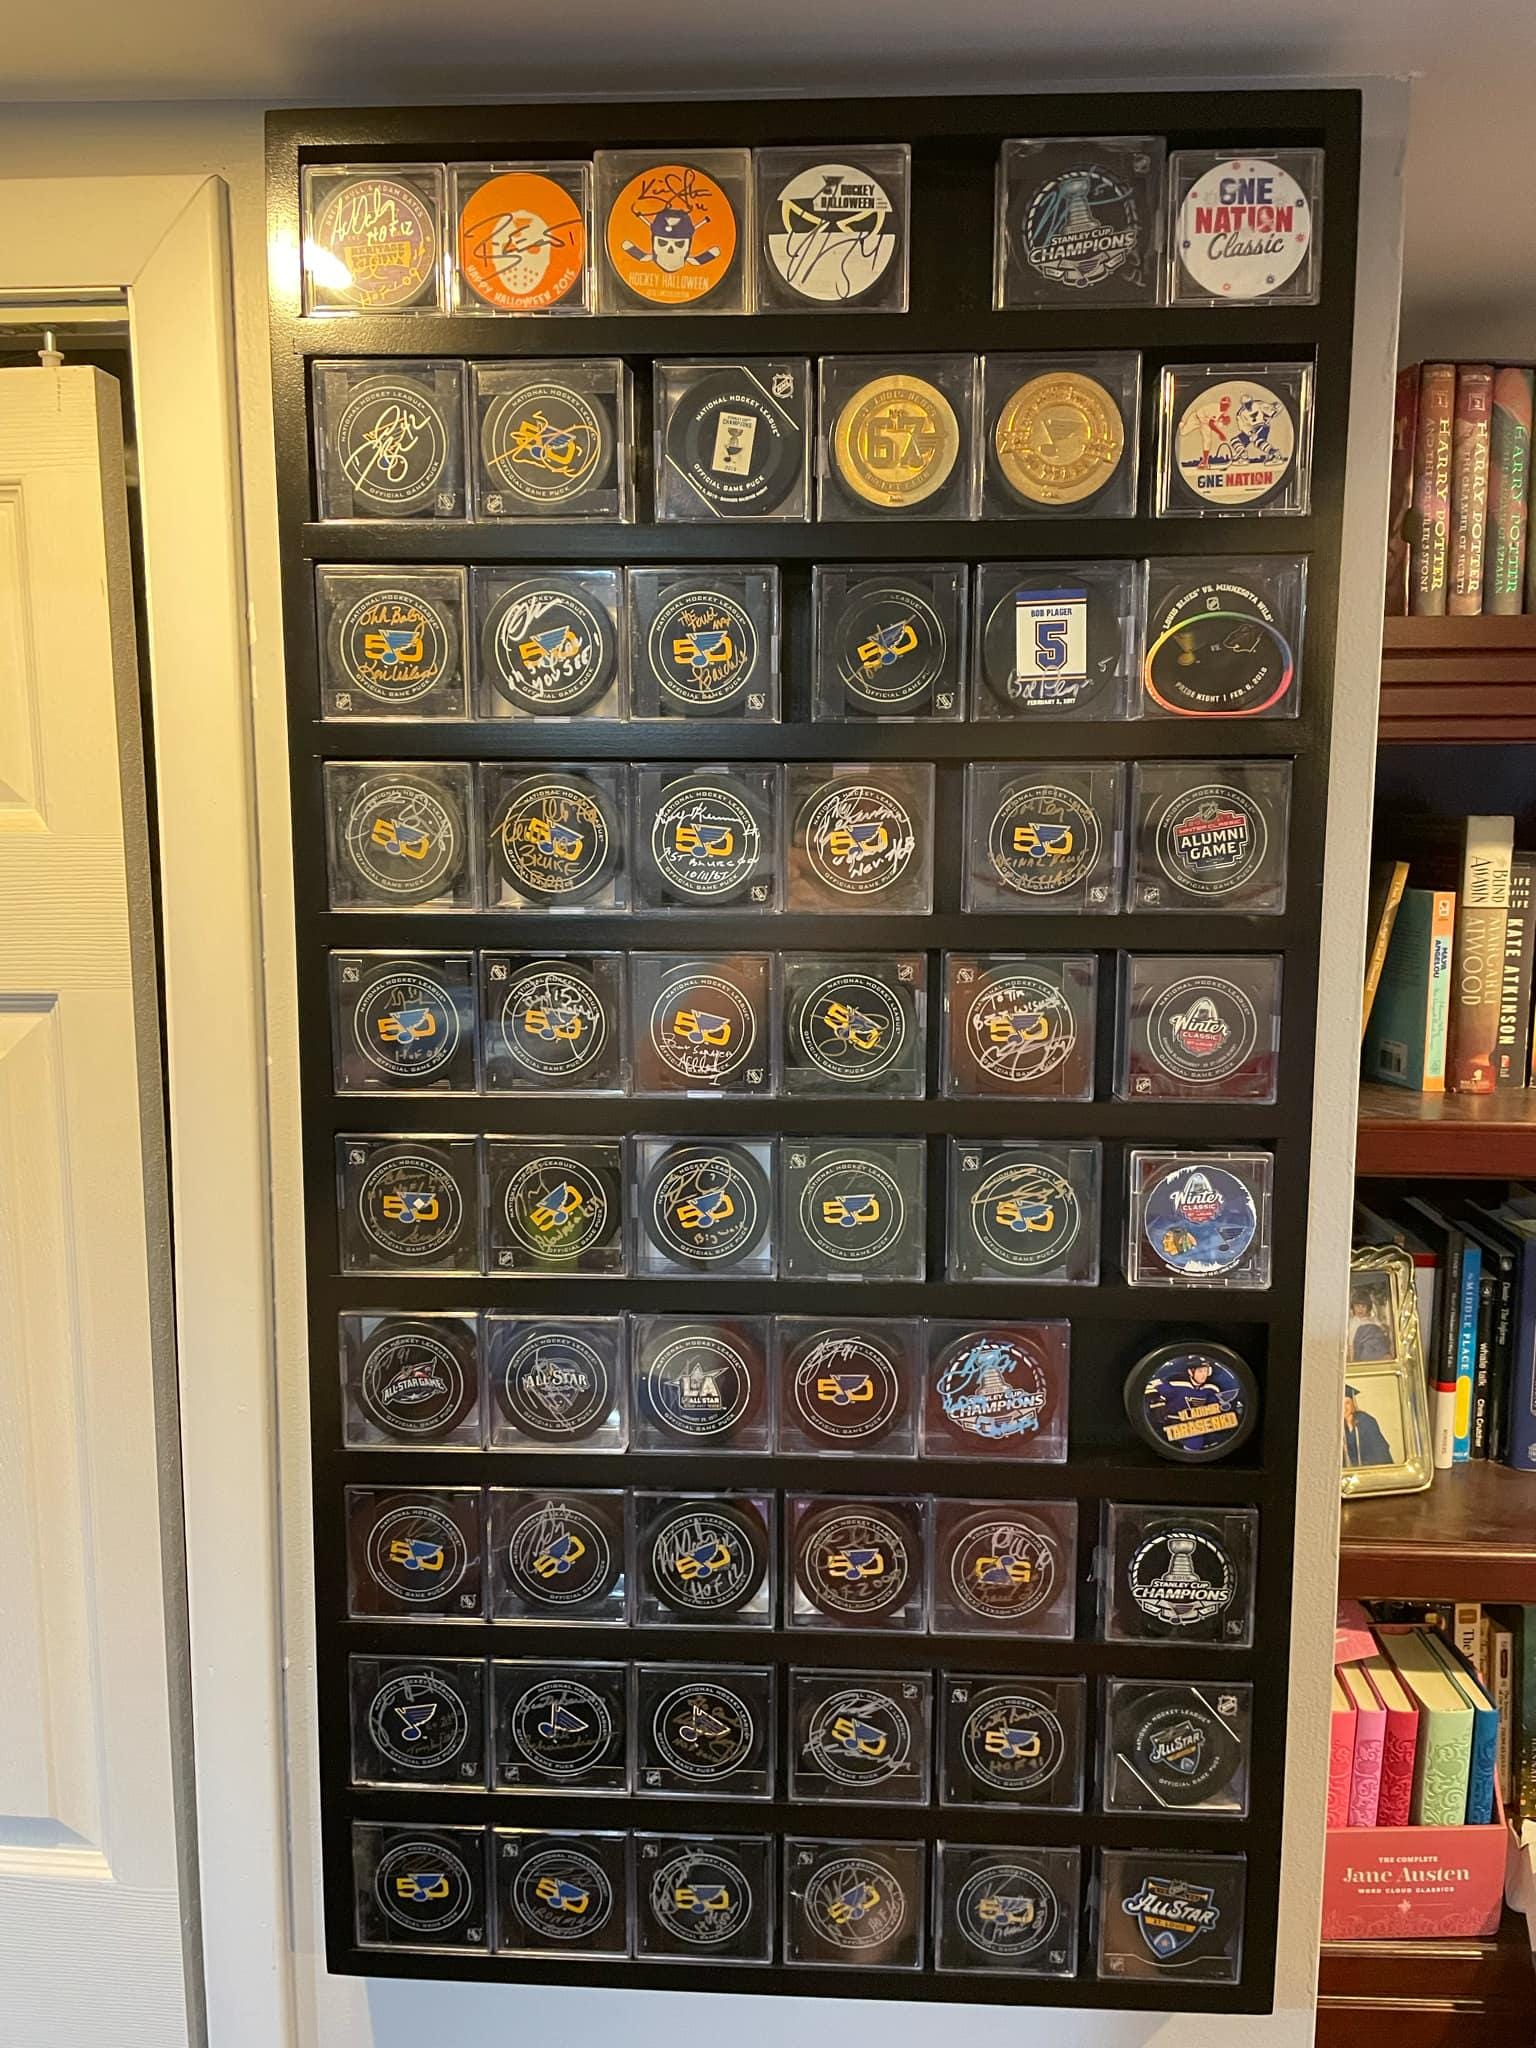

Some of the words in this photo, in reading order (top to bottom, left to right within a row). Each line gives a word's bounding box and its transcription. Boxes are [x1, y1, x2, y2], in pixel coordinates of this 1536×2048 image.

[840, 183, 875, 197] HOCKEY
[1194, 205, 1294, 234] NATION
[1029, 231, 1136, 263] CHAMPIONS
[1051, 231, 1091, 246] STANLEY
[1091, 228, 1112, 239] CUP
[1208, 231, 1285, 261] Classic
[466, 264, 493, 292] HAPPY
[494, 289, 551, 308] HALLOWEEN
[628, 272, 659, 286] HOCKEY
[662, 273, 709, 289] HALLOWEEN
[696, 396, 727, 422] NATIONAL
[729, 395, 760, 408] HOCKEY
[1437, 419, 1451, 502] HARRY
[1472, 420, 1488, 505] HARRY
[1511, 425, 1525, 504] HARRY
[694, 463, 720, 489] OFFICIAL
[746, 475, 765, 489] PUCK
[1225, 471, 1273, 487] NATION
[1431, 510, 1446, 591] POTTER
[1467, 512, 1482, 594] POTTER
[1506, 513, 1521, 594] POTTER
[1420, 553, 1431, 593] STONE
[1216, 584, 1258, 604] MINNESOTA
[350, 598, 379, 623] NATIONAL
[382, 595, 413, 603] HOCKEY
[656, 601, 682, 632] NATIONAL
[1031, 609, 1044, 617] BOB
[1047, 608, 1072, 616] PLAGER
[1035, 620, 1068, 671] 5
[356, 674, 386, 695] OFFICIAL
[667, 681, 699, 699] OFFICIAL
[1196, 693, 1220, 703] NIGHT
[663, 793, 693, 818] NATIONAL
[696, 792, 727, 800] HOCKEY
[1163, 797, 1191, 828] NATIONAL
[1192, 789, 1225, 798] HOCKEY
[1181, 827, 1244, 849] ALUMNI
[1191, 842, 1237, 860] GAME
[666, 866, 694, 888] OFFICIAL
[1491, 870, 1508, 902] BLIND
[1510, 878, 1531, 886] IFE
[1507, 900, 1529, 908] IFE
[1505, 918, 1523, 957] KATE
[1461, 917, 1485, 1005] ATWOOD
[665, 980, 697, 999] NATIONAL
[701, 980, 730, 992] HOCKEY
[1159, 983, 1192, 1006] NATIONAL
[1499, 965, 1520, 1044] ATKINSON
[1169, 1014, 1231, 1037] Winter
[1182, 1031, 1218, 1040] CLASSIC
[1170, 1191, 1224, 1210] Winter
[1464, 1281, 1474, 1328] MIDDLE
[1461, 1333, 1471, 1370] PLACE
[1162, 1411, 1239, 1441] TARASENKO
[1132, 1586, 1229, 1601] CHAMPIONS
[1153, 1580, 1188, 1589] STANLEY
[1189, 1581, 1209, 1589] CUP
[1462, 1628, 1474, 1650] The
[1344, 1867, 1392, 1882] Jane
[1396, 1867, 1470, 1882] Austen
